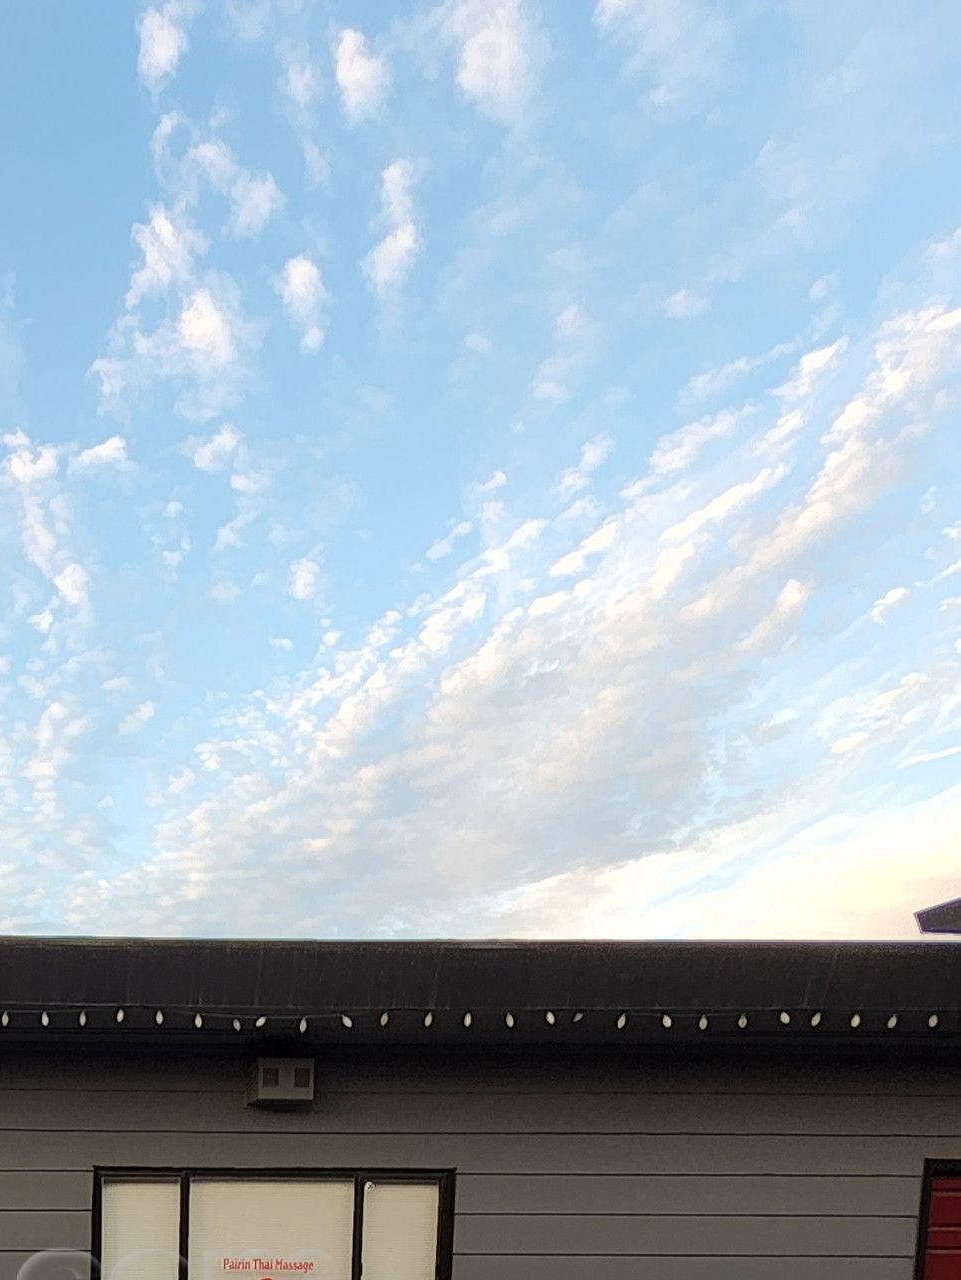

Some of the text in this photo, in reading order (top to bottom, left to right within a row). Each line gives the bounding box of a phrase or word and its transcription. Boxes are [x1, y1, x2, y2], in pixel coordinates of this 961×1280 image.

[223, 1257, 314, 1274] Pairin Thai Massage
